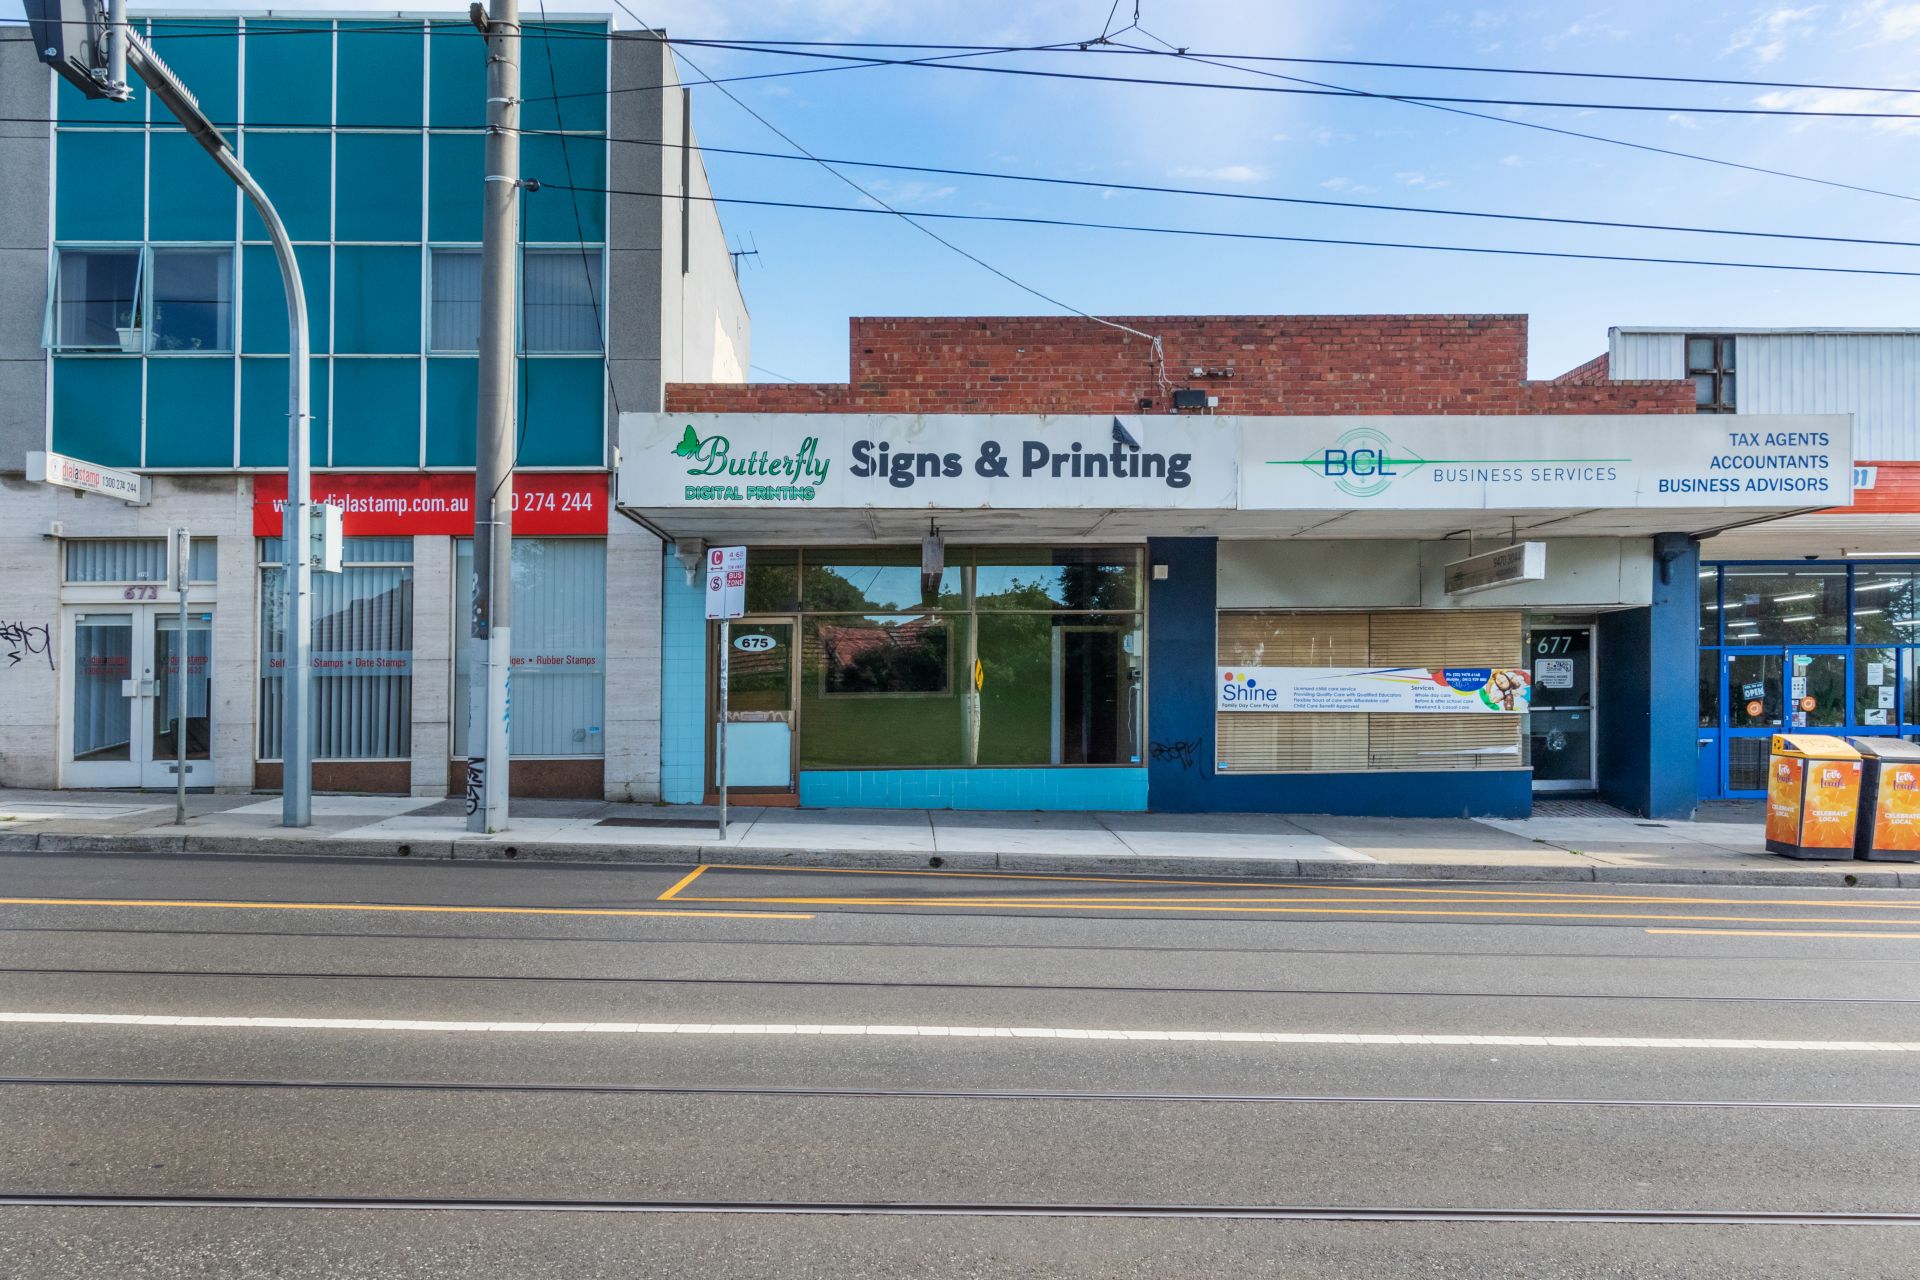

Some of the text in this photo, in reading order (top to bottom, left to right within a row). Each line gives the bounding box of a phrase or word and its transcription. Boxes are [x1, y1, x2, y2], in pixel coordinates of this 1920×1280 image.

[1729, 432, 1829, 447] TAX AGENTS
[686, 435, 831, 486] Butterfly
[849, 440, 1192, 489] Signs & Printing
[1324, 449, 1397, 476] BCL
[1710, 455, 1829, 469] ACCOUNTANTS
[62, 461, 100, 488] dialastamp
[1433, 467, 1617, 482] BUSINESS SERVICES
[1658, 477, 1829, 493] BUSINESS ADVISORS
[684, 485, 816, 501] DIGITAL PRINTING
[524, 492, 556, 512] 274
[561, 492, 593, 512] 244
[727, 579, 743, 587] ZONE
[124, 585, 157, 600] 673
[742, 638, 769, 648] 675
[1537, 636, 1572, 654] 677
[314, 657, 406, 669] Stamps Date Stamps
[536, 656, 563, 665] Rubber
[566, 655, 596, 666] Stamps
[1223, 679, 1277, 701] Shine
[1744, 688, 1764, 698] OPEN
[1771, 803, 1795, 813] CELEBRATE
[1884, 812, 1920, 820] CELEBRATE
